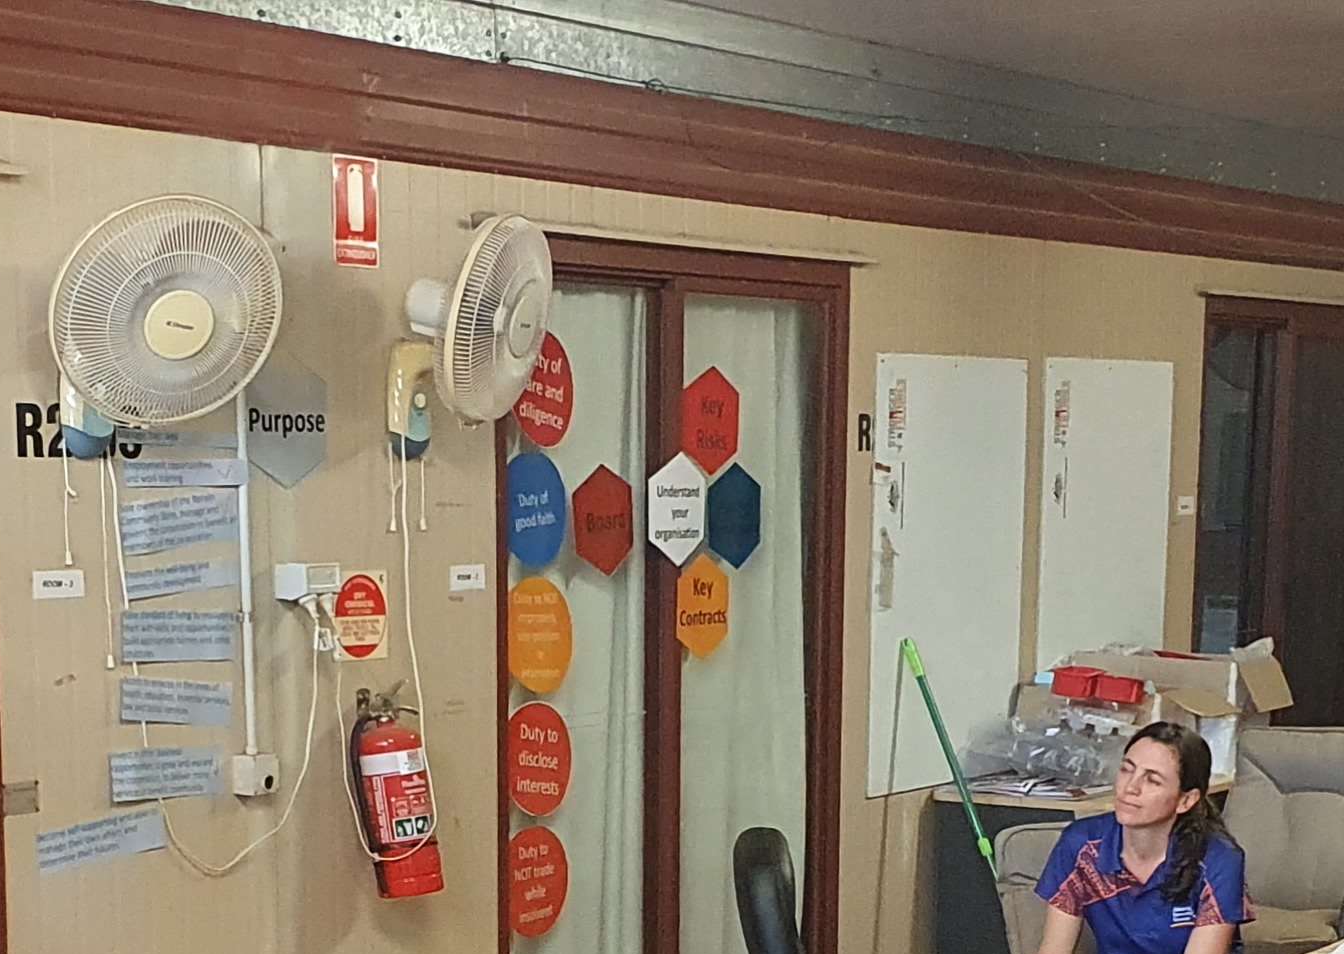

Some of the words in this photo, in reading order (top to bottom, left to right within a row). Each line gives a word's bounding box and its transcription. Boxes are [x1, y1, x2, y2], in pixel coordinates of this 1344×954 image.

[550, 357, 563, 374] of
[544, 386, 565, 403] and
[519, 401, 565, 431] diligence
[700, 395, 725, 420] Key
[247, 405, 326, 438] Purpose
[696, 428, 728, 452] Risks
[655, 484, 700, 500] Understand
[515, 516, 537, 533] good
[537, 512, 556, 528] faith
[585, 512, 627, 532] Board
[670, 507, 690, 522] your
[654, 525, 701, 544] organisation
[692, 577, 715, 601] Key
[678, 609, 728, 628] Contracts
[519, 723, 546, 745] Duty
[547, 726, 559, 743] to
[518, 750, 559, 770] disclose
[516, 776, 560, 797] interests
[518, 845, 539, 861] Duty
[539, 843, 549, 856] to
[533, 861, 556, 879] trade
[523, 884, 547, 902] while
